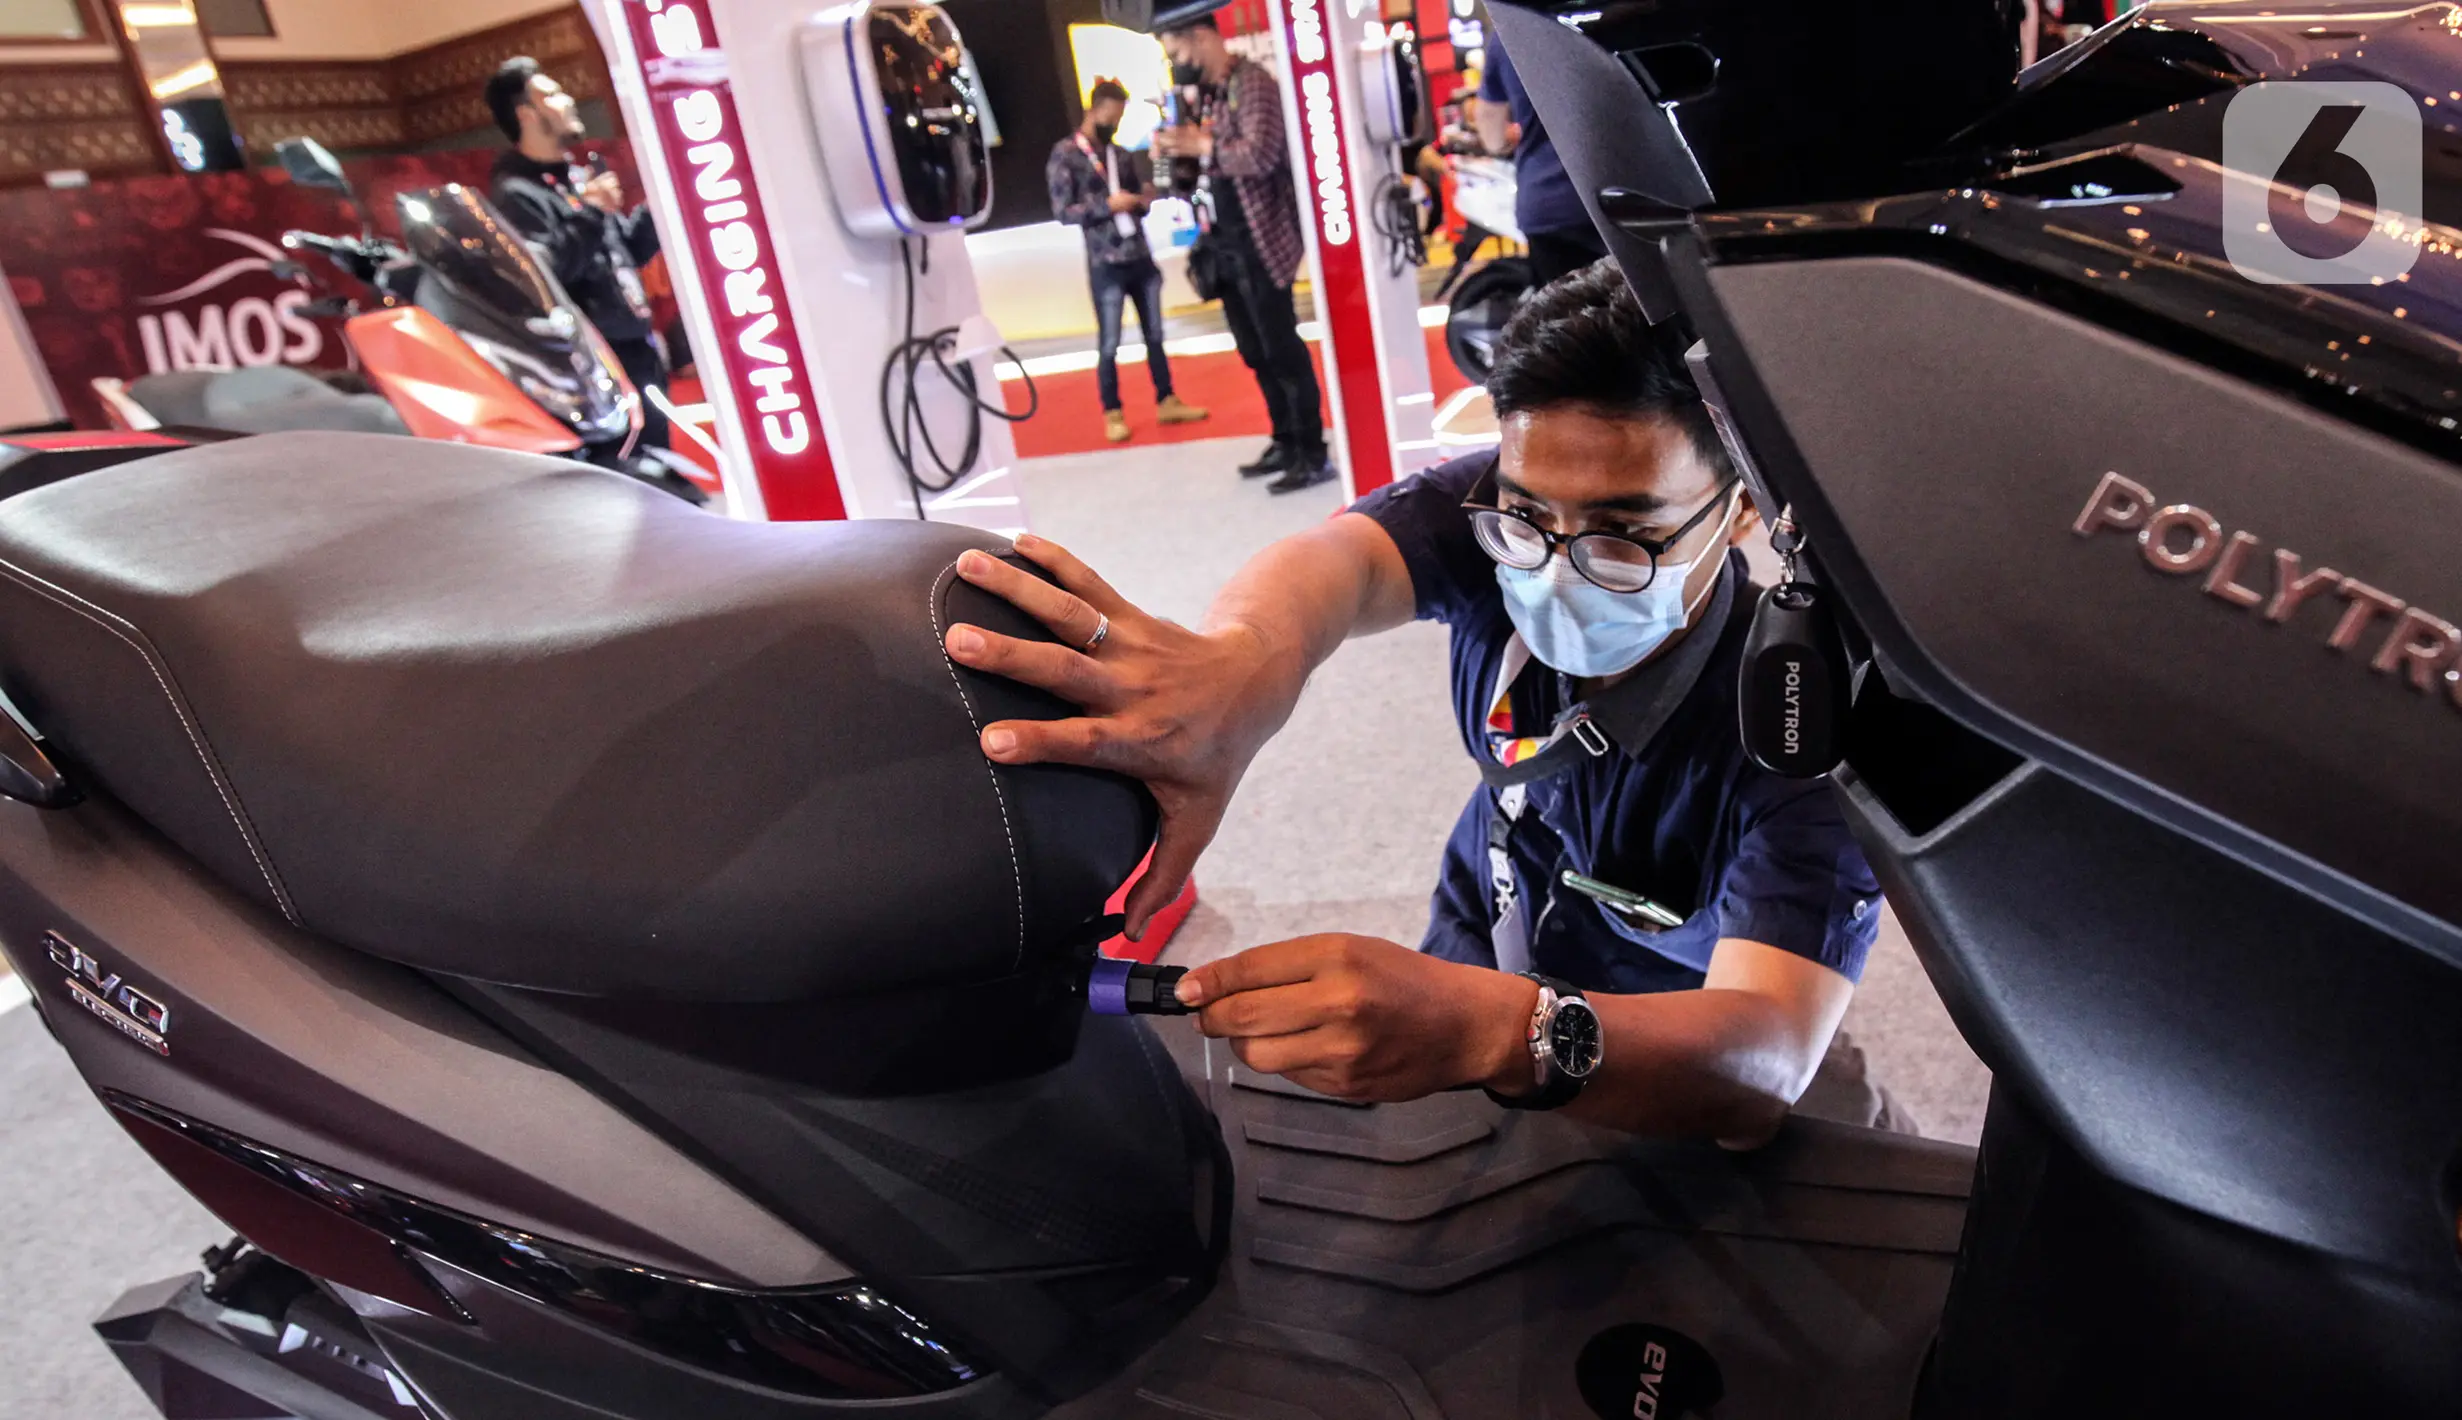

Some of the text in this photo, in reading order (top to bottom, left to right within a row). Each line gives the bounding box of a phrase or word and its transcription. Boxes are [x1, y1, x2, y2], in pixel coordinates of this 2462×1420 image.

[645, 0, 810, 455] CHARGING S
[1302, 71, 1351, 245] CHARGING
[137, 289, 323, 375] IMOS
[2072, 471, 2462, 712] POLYTR
[1785, 661, 1800, 754] POLYTRON
